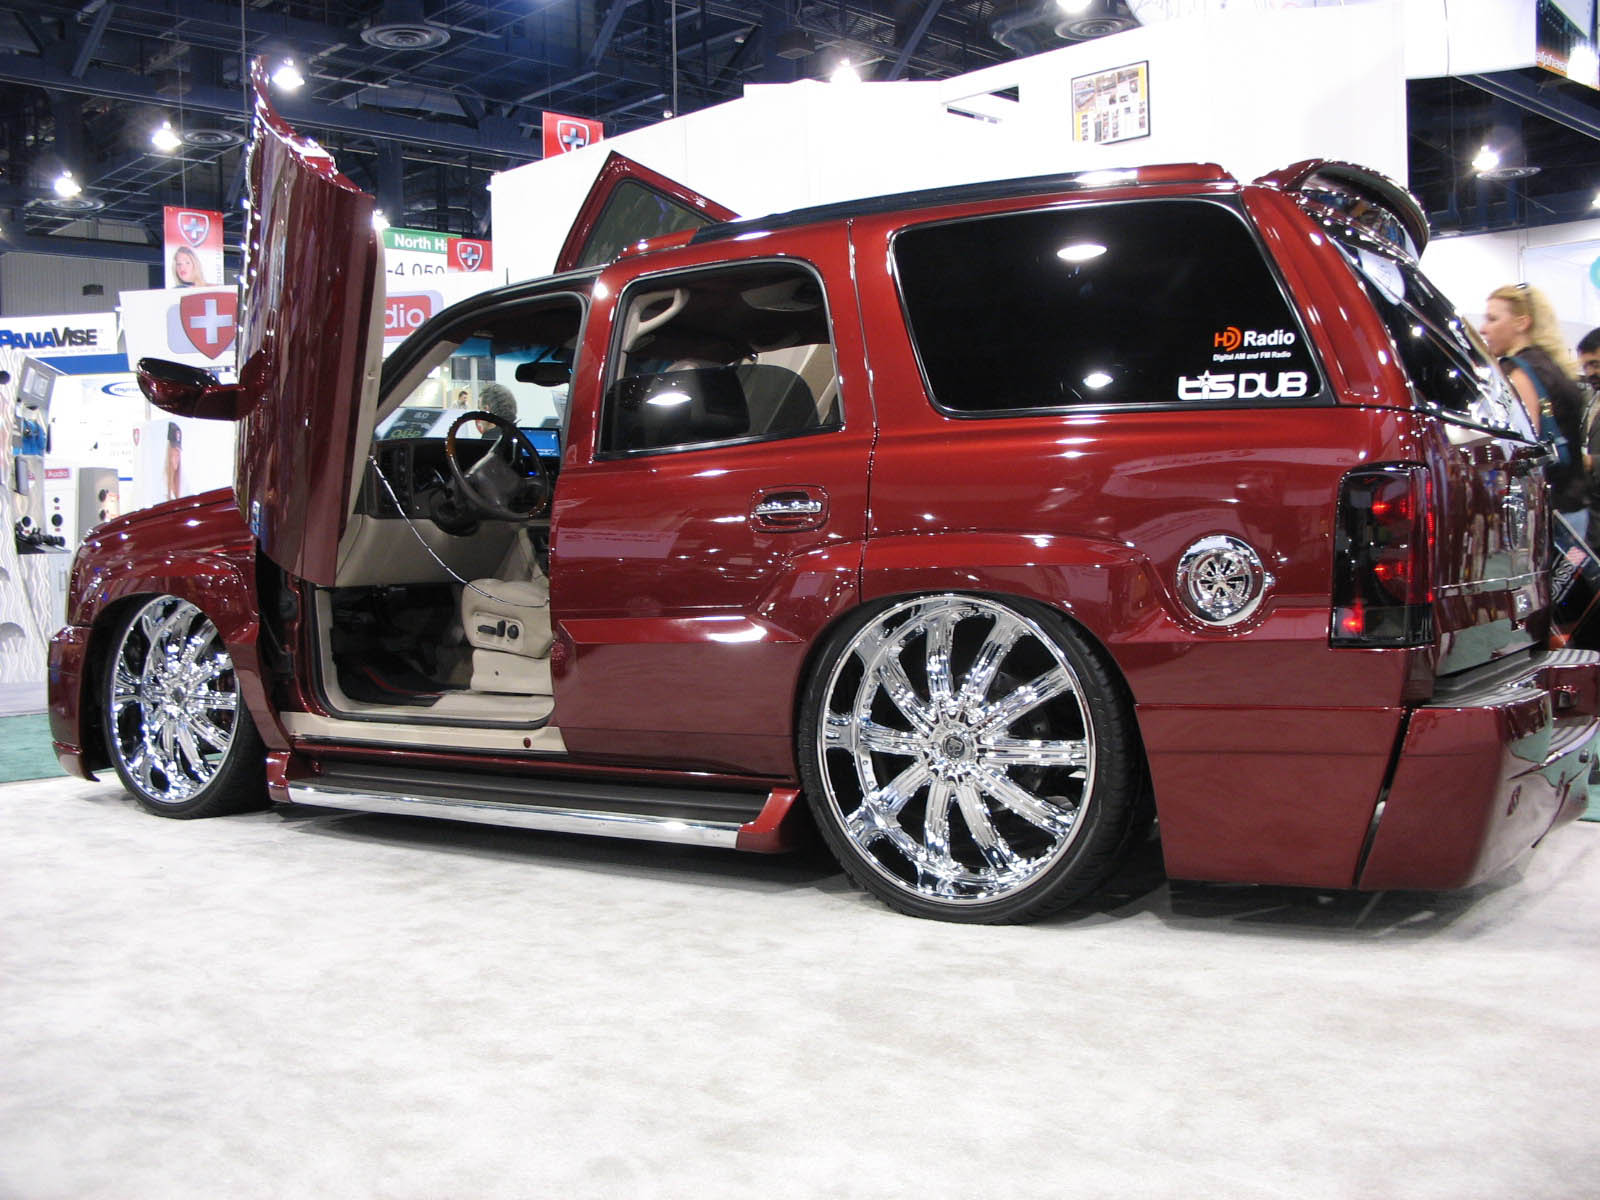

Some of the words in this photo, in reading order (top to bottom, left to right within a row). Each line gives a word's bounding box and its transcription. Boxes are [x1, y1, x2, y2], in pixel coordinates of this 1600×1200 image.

[394, 234, 432, 250] North
[385, 304, 424, 328] dio
[1214, 328, 1240, 350] HD
[1243, 329, 1295, 347] Radio
[1213, 353, 1234, 362] Digital
[1260, 351, 1271, 359] FM
[1238, 371, 1307, 398] DUB
